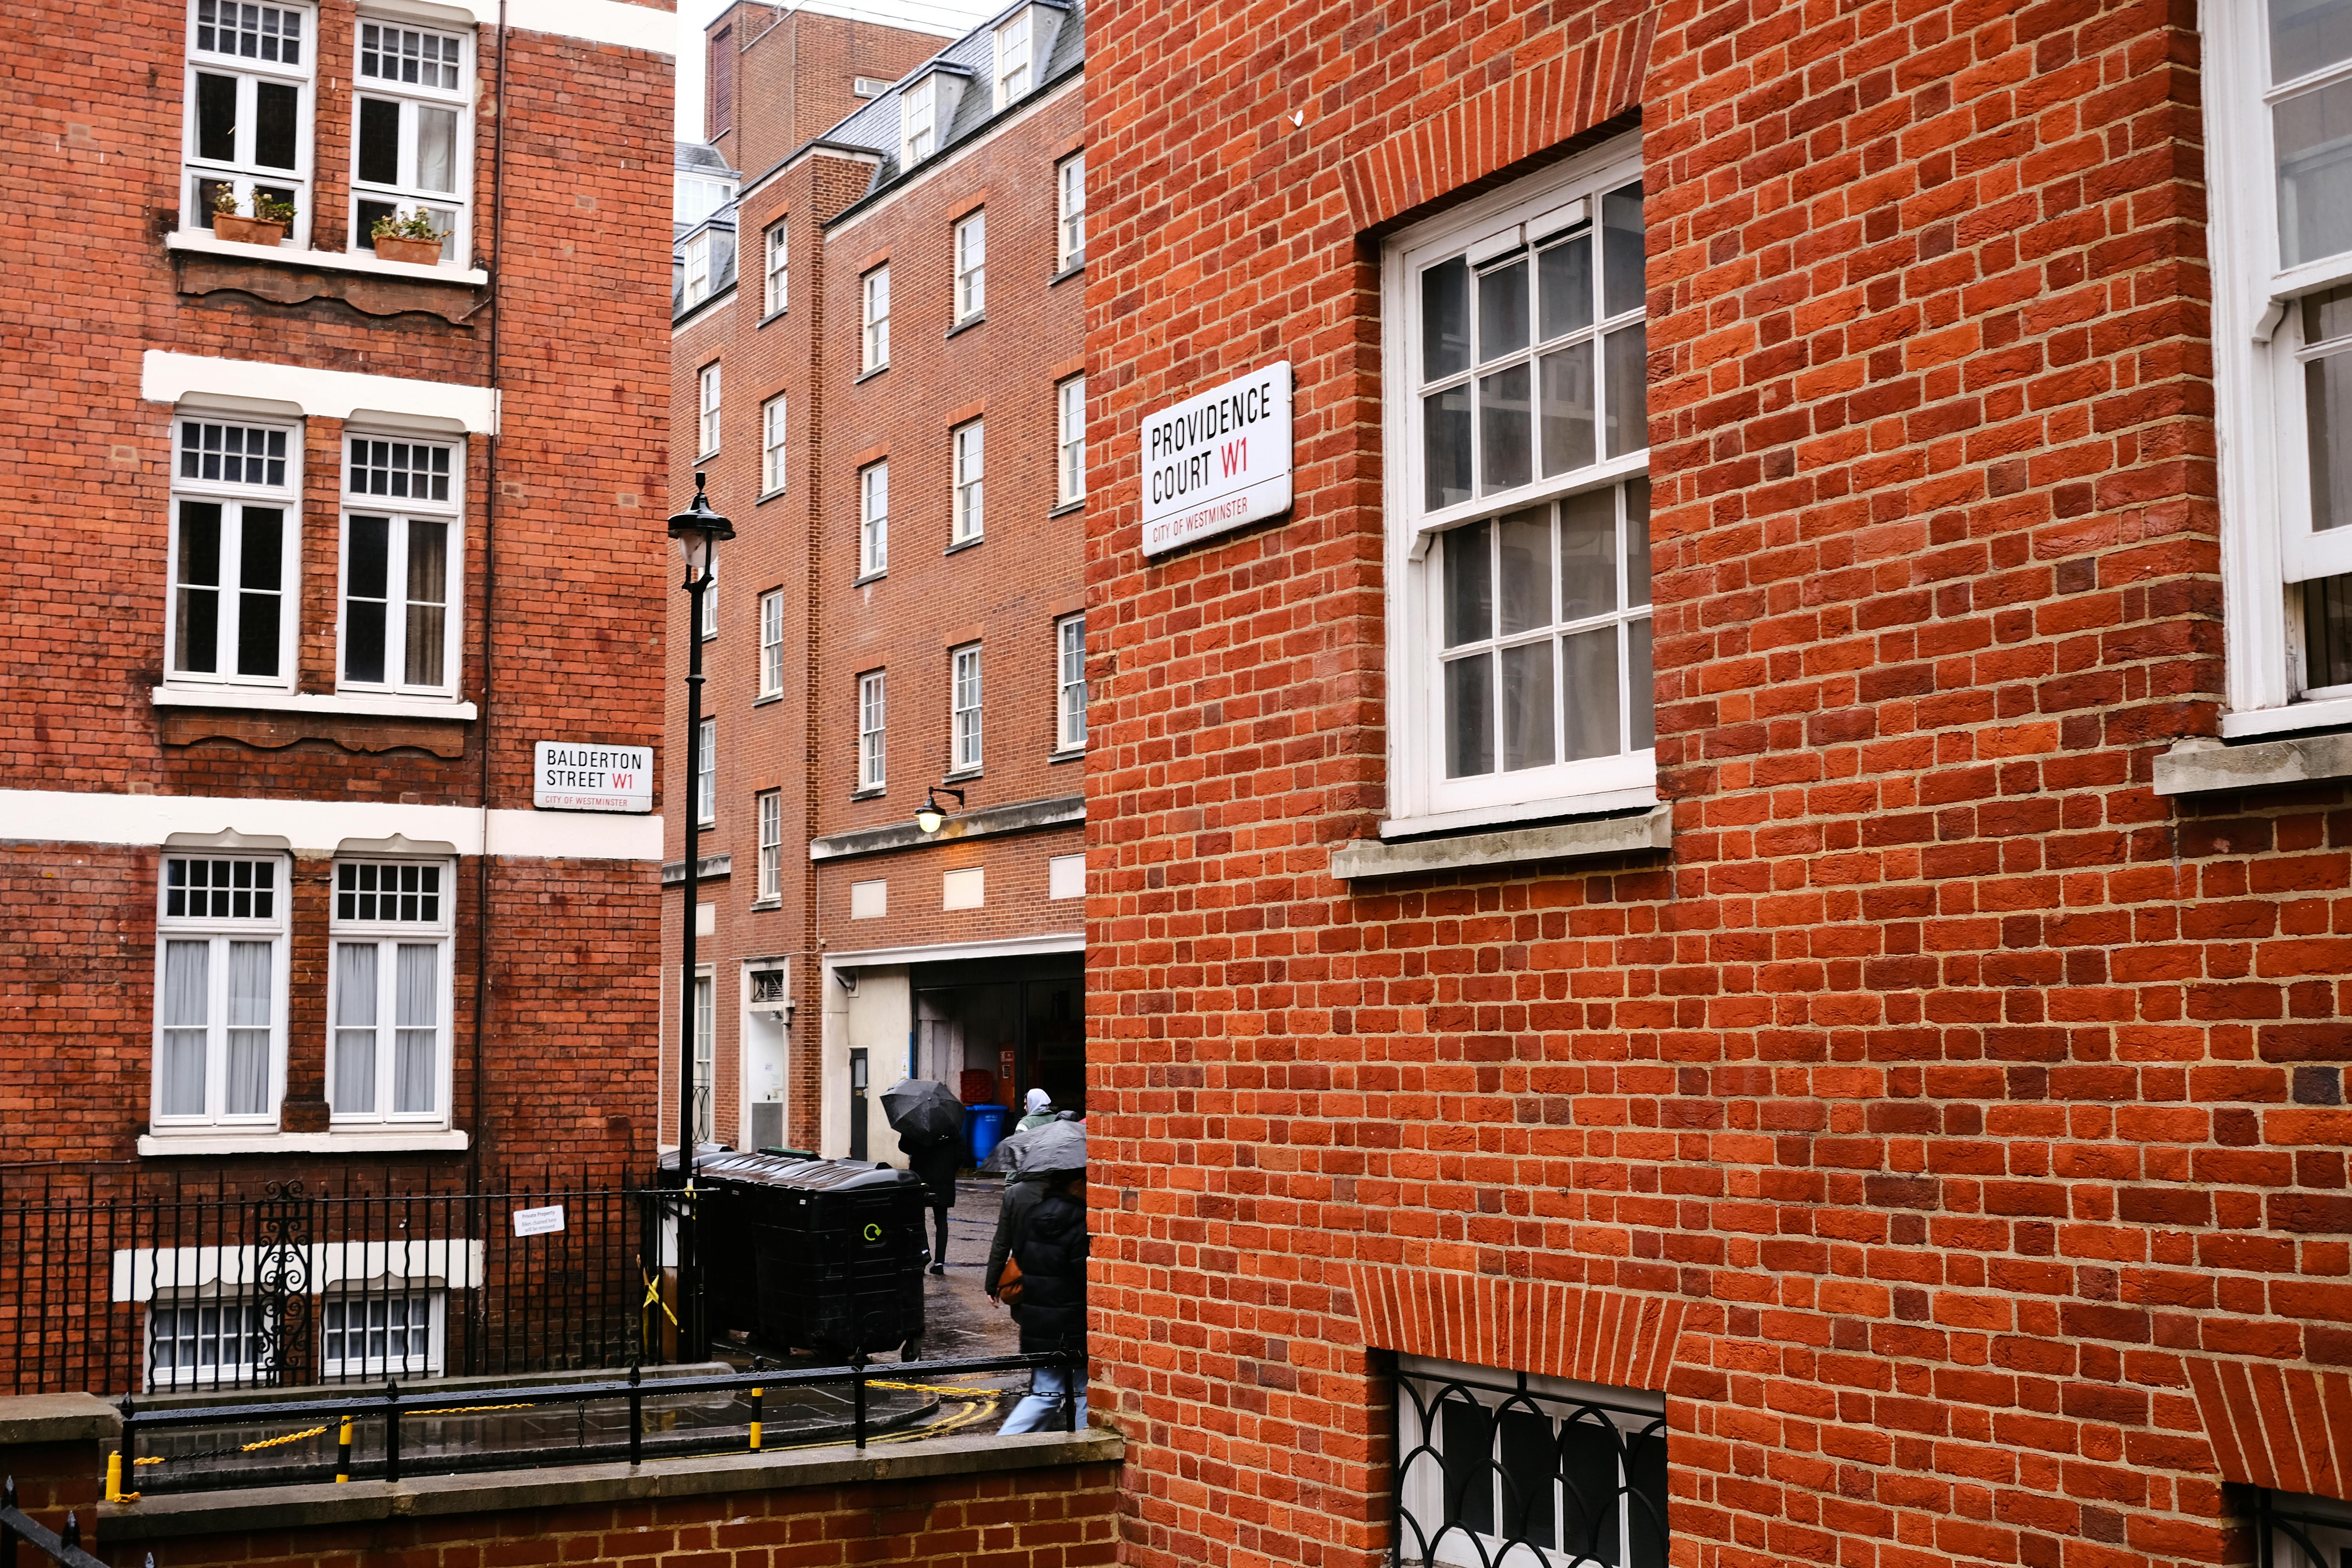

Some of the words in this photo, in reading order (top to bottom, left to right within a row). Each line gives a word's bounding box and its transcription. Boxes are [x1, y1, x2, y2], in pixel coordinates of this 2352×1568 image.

[1152, 382, 1270, 462] PROVIDENCE
[1153, 451, 1211, 504] COURT
[1221, 436, 1247, 478] W1
[1153, 523, 1170, 543] CITY
[1173, 519, 1183, 536] OF
[1185, 497, 1248, 531] WESTMINSTER
[547, 749, 641, 769] BALDERTON
[547, 770, 605, 788] STREET
[612, 773, 633, 789] W1
[576, 797, 627, 806] WESTMINSTER
